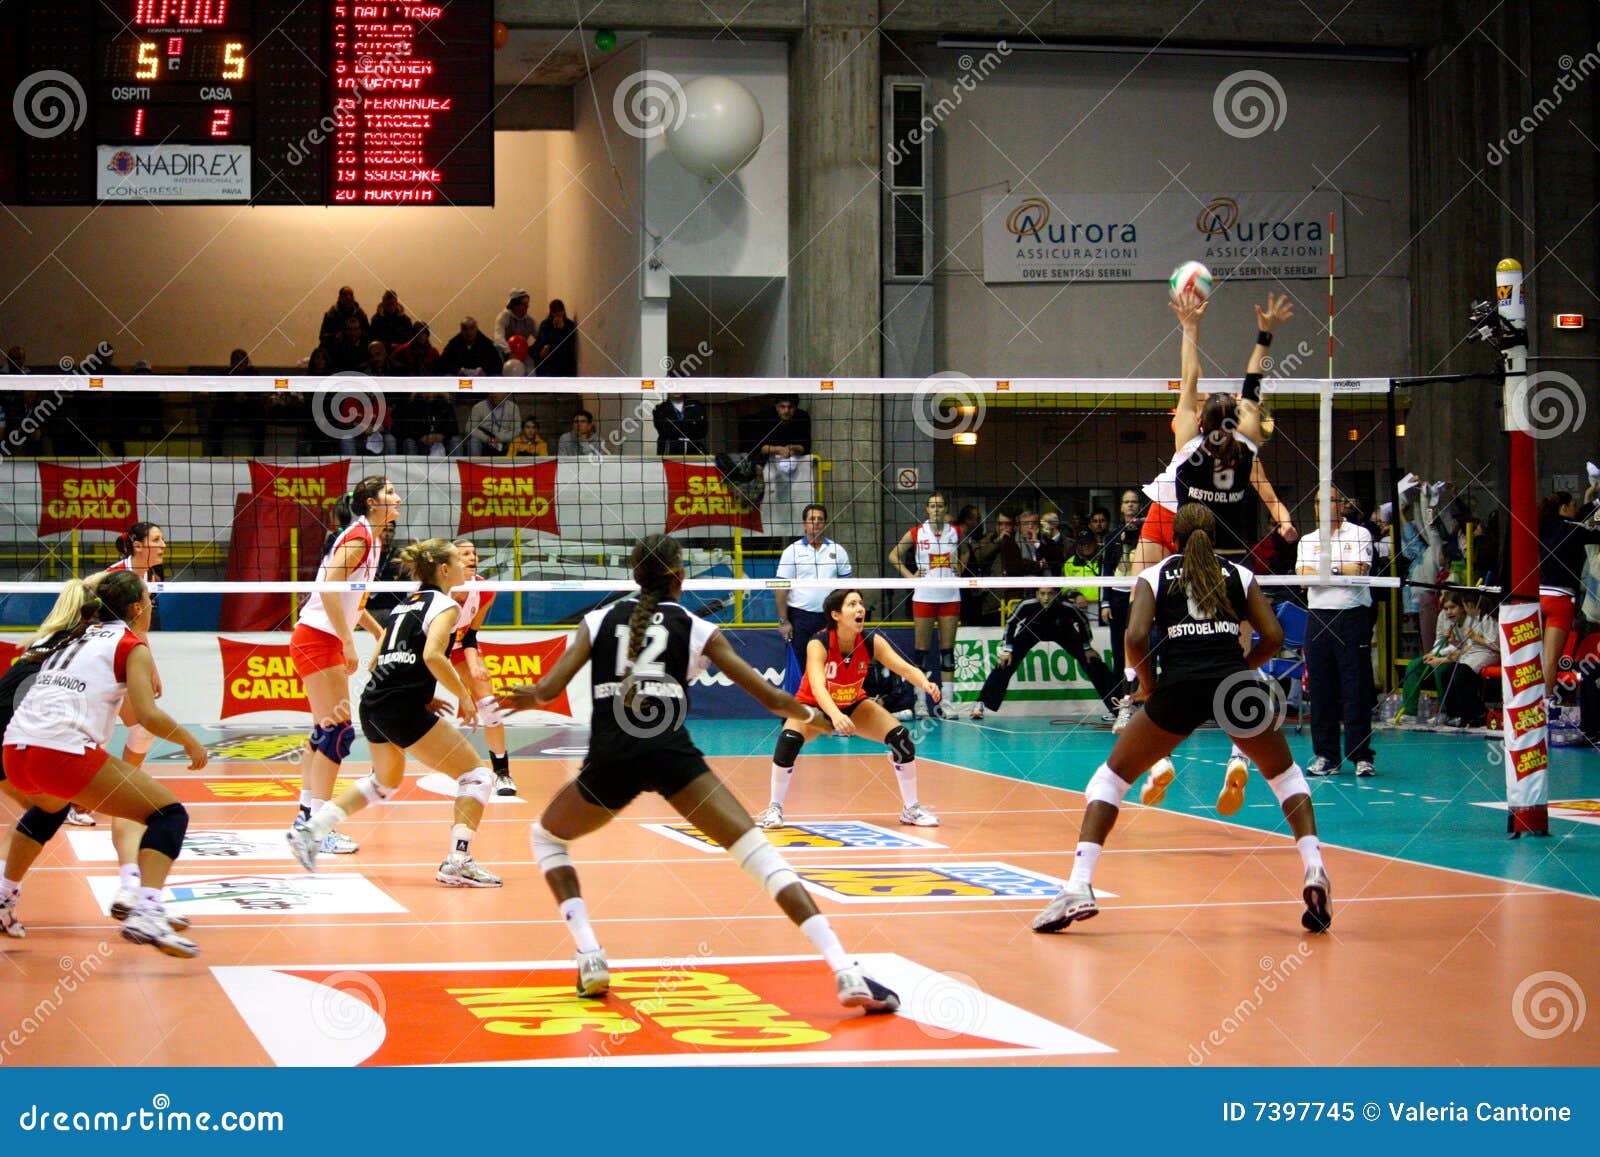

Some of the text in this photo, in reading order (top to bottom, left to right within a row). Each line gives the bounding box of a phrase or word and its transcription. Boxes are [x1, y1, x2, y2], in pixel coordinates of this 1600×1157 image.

[136, 43, 158, 79] 5
[222, 43, 245, 79] 5
[112, 87, 150, 100] OSPITI
[200, 87, 232, 100] CASA
[134, 109, 144, 136] 1
[211, 109, 231, 136] 2
[135, 154, 242, 175] NADIREX
[106, 186, 183, 197] CONGRESSI
[1016, 215, 1137, 243] Aurora
[1206, 214, 1322, 242] Aurora
[1016, 248, 1138, 259] ASSICURAZIONI
[1206, 246, 1323, 257] ASSICURAZIONI
[1023, 268, 1132, 279] DOVE SENTIRSI SERENI
[1212, 266, 1317, 277] DOVE SENTIRSI SERENI
[63, 478, 116, 498] SAN
[273, 478, 326, 497] SAN
[482, 477, 535, 497] SAN
[1188, 486, 1214, 502] RESTO
[1214, 492, 1228, 503] DEL
[48, 499, 131, 520] CARLO
[467, 497, 550, 517] CARLO
[920, 539, 931, 551] 15
[1167, 623, 1196, 639] RESTO
[1195, 622, 1214, 635] DEL
[1509, 627, 1541, 647] CARLO
[1512, 620, 1534, 636] SAN
[614, 624, 669, 678] 12
[484, 655, 542, 677] SAN
[1515, 663, 1537, 678] SAN
[230, 678, 308, 700] CARL
[1513, 670, 1542, 689] CARLO
[1514, 712, 1545, 731] CARLO
[1517, 705, 1539, 720] SAN
[1517, 755, 1547, 774] CARLO
[1520, 748, 1541, 763] SAN
[444, 984, 643, 1037] SAN
[606, 970, 832, 1047] CARLO
